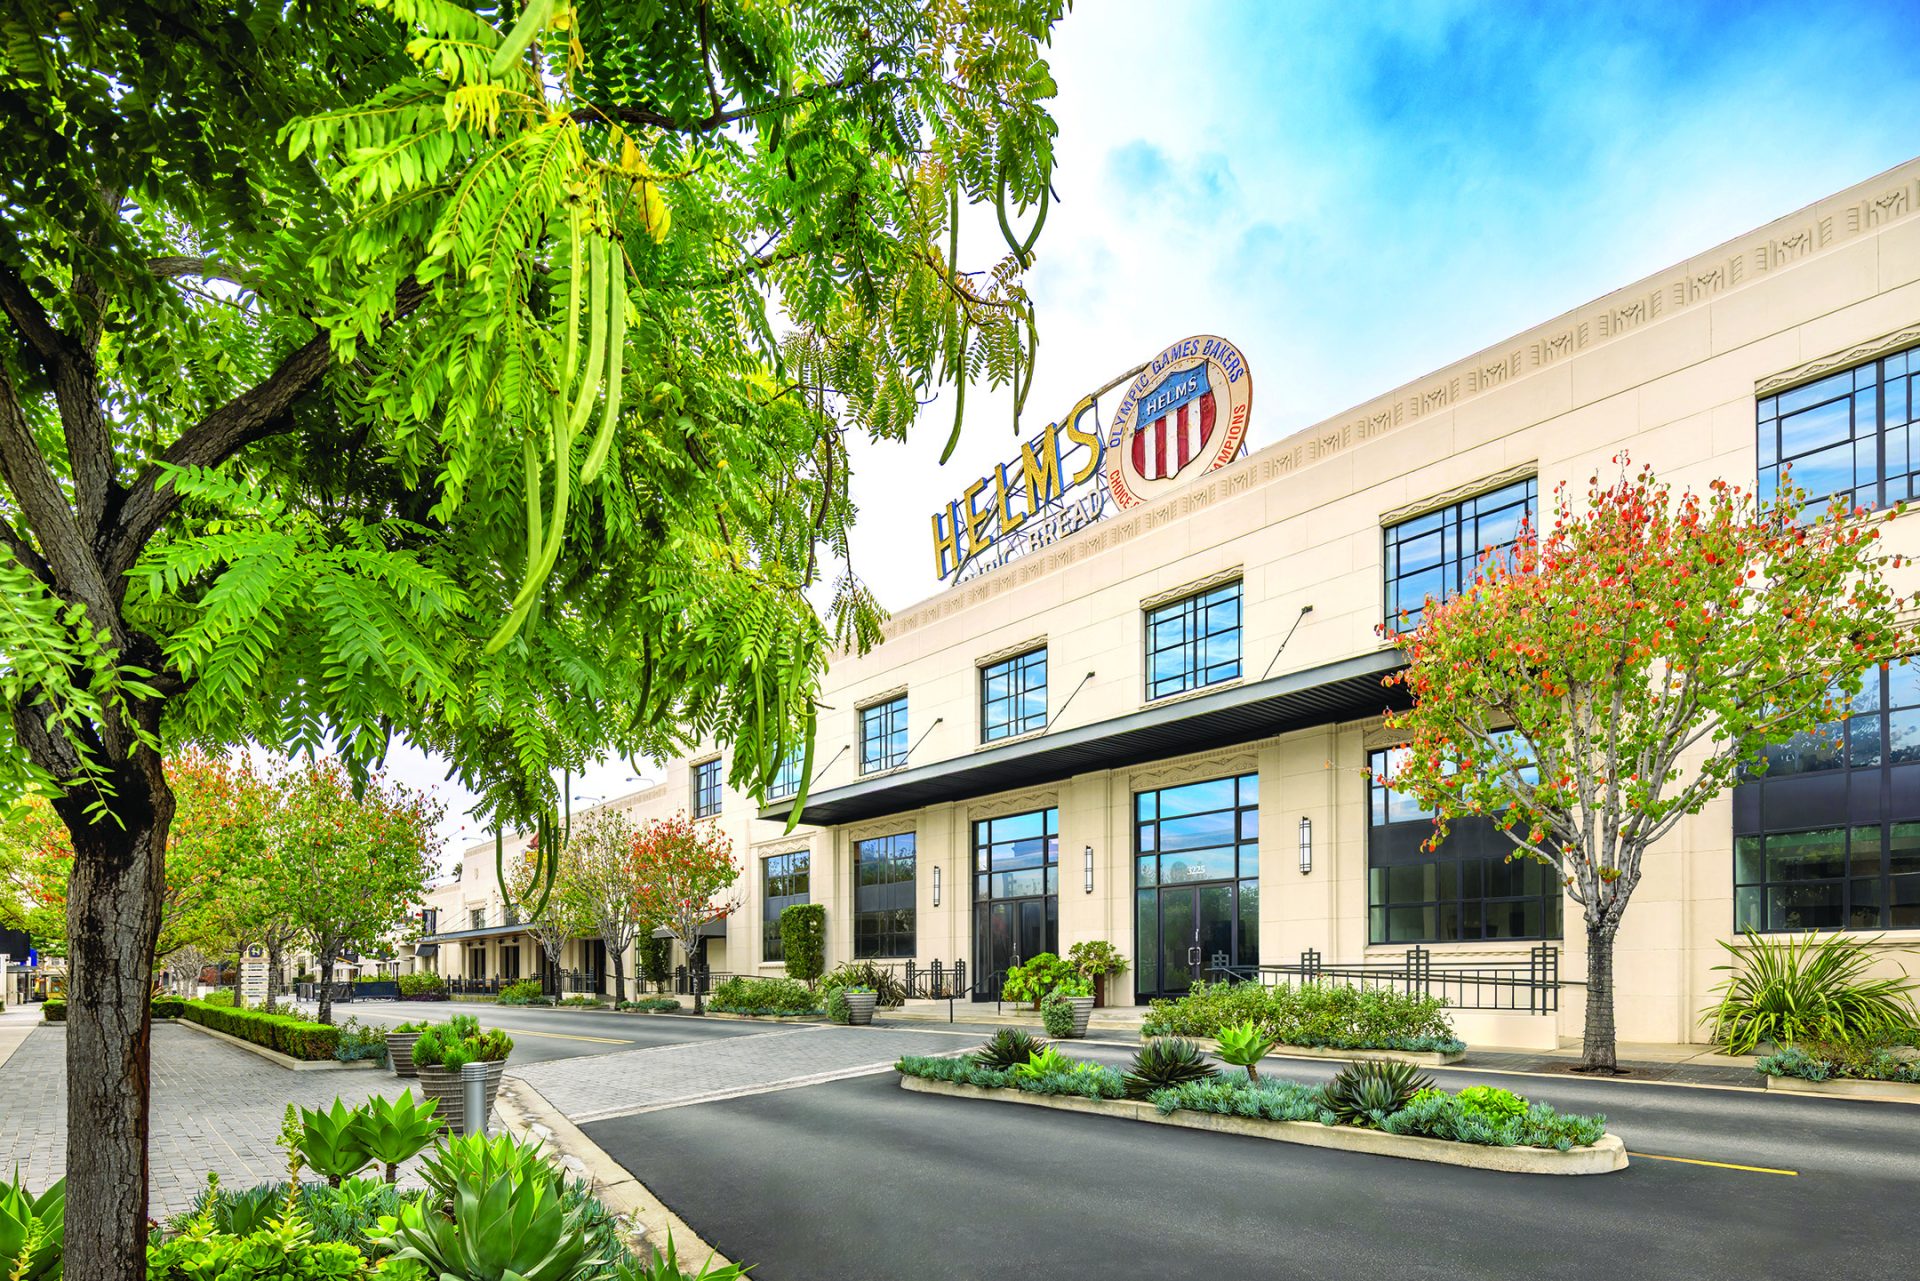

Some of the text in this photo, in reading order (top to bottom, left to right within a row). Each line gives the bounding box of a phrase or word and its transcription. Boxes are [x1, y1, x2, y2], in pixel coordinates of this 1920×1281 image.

[1109, 339, 1244, 448] OLYMPIC GAMES BAKERS
[1146, 376, 1198, 416] HELMS
[931, 394, 1104, 580] HELMS
[1109, 403, 1246, 509] CHOICE AMPIONS
[1028, 488, 1104, 551] BREAD
[1187, 864, 1206, 876] 3225
